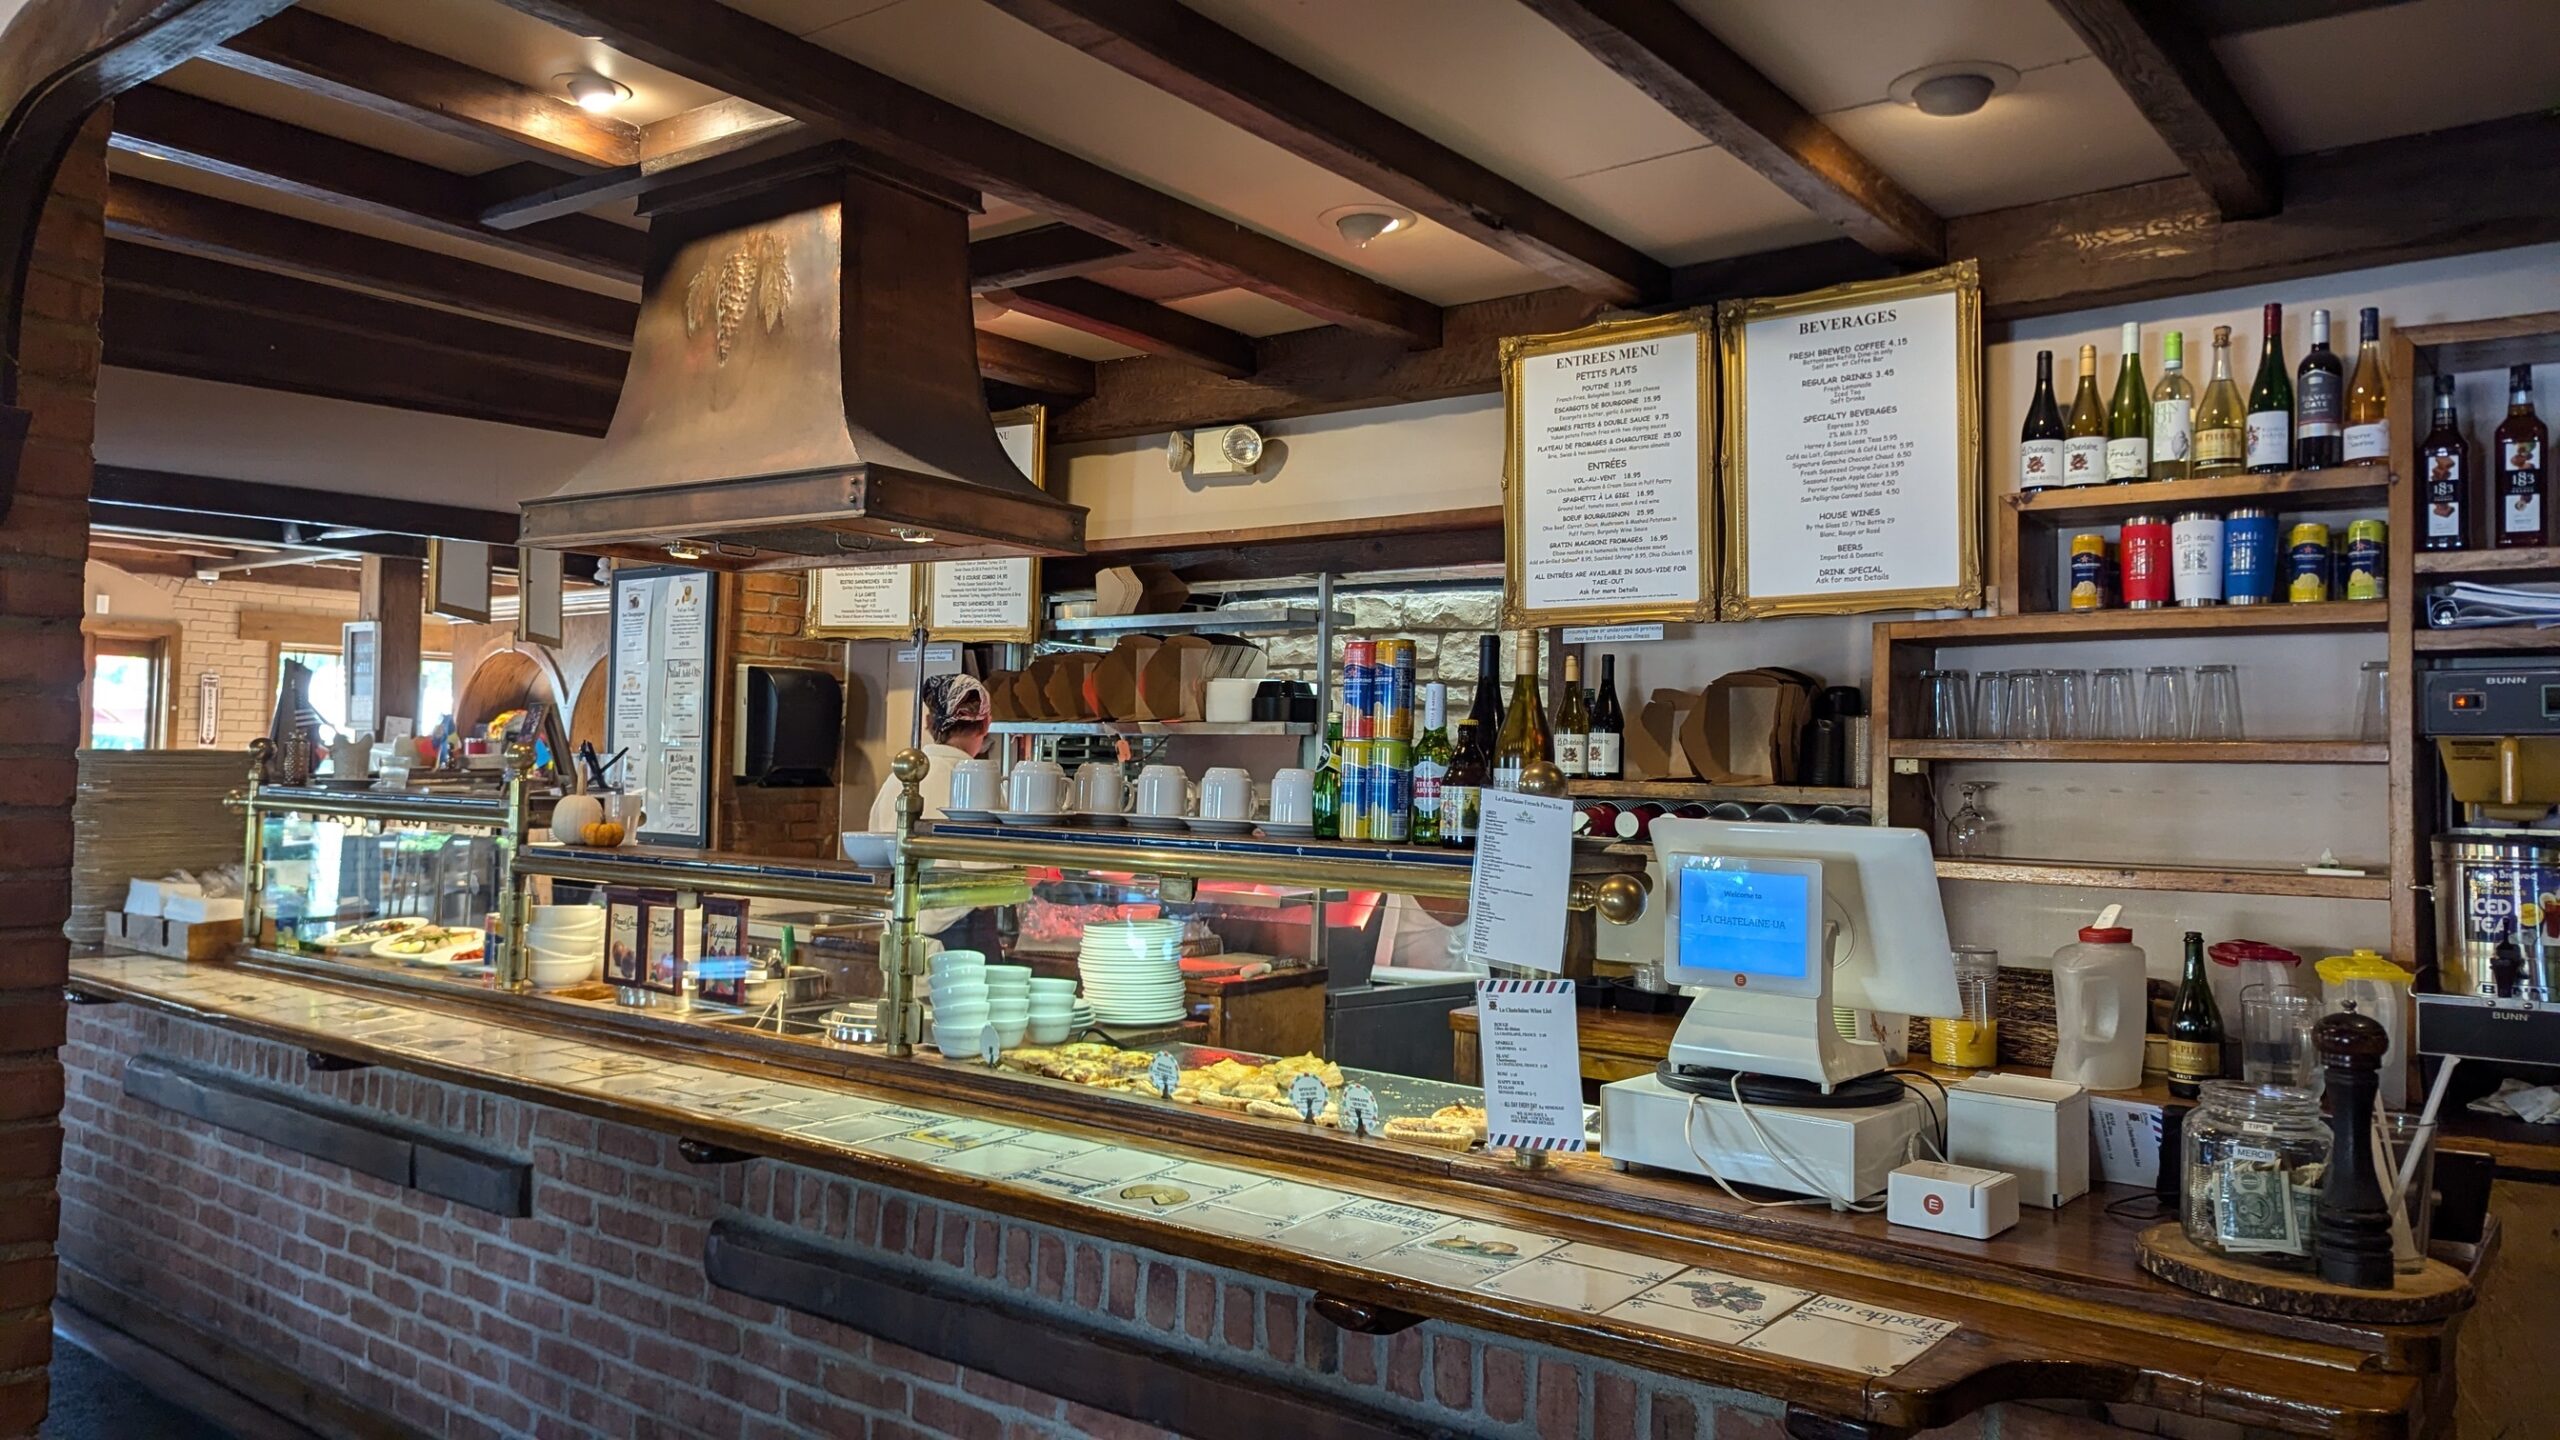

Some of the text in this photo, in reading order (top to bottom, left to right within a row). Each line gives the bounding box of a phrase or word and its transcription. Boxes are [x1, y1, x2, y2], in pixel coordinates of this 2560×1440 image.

[1799, 310, 1897, 335] BEVERAGES
[1789, 338, 1907, 361] FRESH BREWED COFFEE 4.15
[1556, 344, 1659, 369] ENTREES MENU
[1576, 365, 1637, 380] PETITS PLATS
[1802, 377, 1837, 387] REGULAR
[1841, 372, 1872, 382] DRINKS
[1582, 383, 1609, 392] POUTINE
[1554, 404, 1589, 414] ESCARGOTS
[1601, 398, 1638, 408] BOURGOGNE
[1644, 395, 1661, 403] 15.95
[1803, 406, 1897, 423] SPECIALTY BEVERAGES
[1547, 424, 1572, 433] POMMES
[1573, 421, 1595, 429] FRITES
[1604, 418, 1628, 426] DOUBLE
[1630, 416, 1651, 424] SAUCE
[999, 432, 1009, 440] NU
[1537, 444, 1562, 452] PLATEAU
[1575, 439, 1607, 449] FROMAGES
[1616, 434, 1659, 444] CHARCUTERIE
[1588, 458, 1627, 471] ENTRÉES
[1573, 474, 1616, 484] VOL-AU-VENT
[1562, 495, 1596, 504] SPAGHETTI
[1563, 513, 1582, 522] BOEUF
[1584, 511, 1630, 520] BOURGUIGNON
[1819, 509, 1880, 520] HOUSE WINES
[1575, 539, 1607, 547] MACARONI
[1609, 536, 1643, 544] FROMAGES
[1838, 544, 1863, 552] BEERS
[1535, 572, 1545, 580] ALL
[1547, 569, 1573, 579] ENTRÉES
[1589, 568, 1622, 577] AVAILABLE
[1635, 566, 1671, 575] SOUS-VIDE
[1849, 566, 1882, 574] SPECIAL
[1592, 578, 1624, 586] TAKE-OUT
[2486, 677, 2527, 685] BUNN
[1724, 890, 1753, 899] Welcome
[2470, 898, 2512, 915] ICED
[1701, 915, 1786, 930] LA CHATELAINE-UA
[2492, 1011, 2528, 1021] BUNN
[2248, 1123, 2268, 1131] TIPS
[1812, 1297, 1947, 1333] bon appétit
